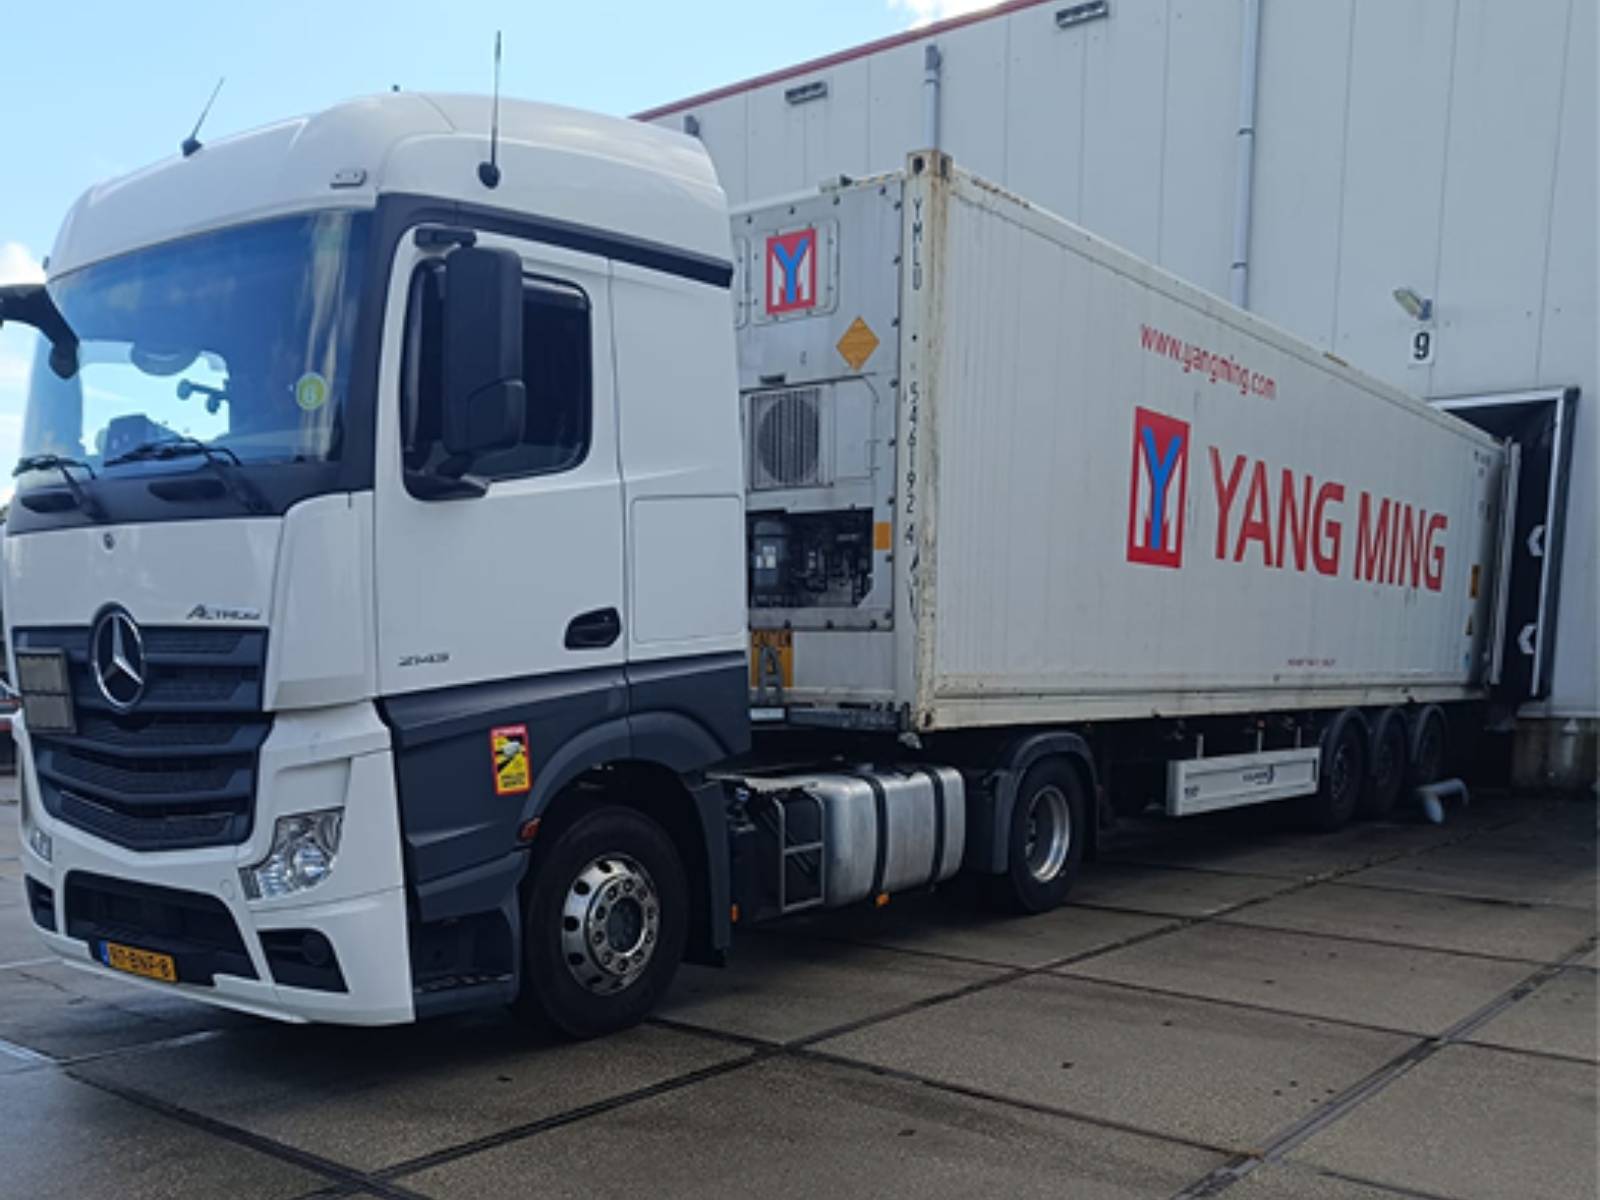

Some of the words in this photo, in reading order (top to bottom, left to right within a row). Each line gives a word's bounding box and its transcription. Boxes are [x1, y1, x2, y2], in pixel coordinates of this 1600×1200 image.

[911, 198, 924, 290] YMLU
[1140, 322, 1276, 400] www.yangming.com
[1413, 331, 1430, 360] 9
[1209, 446, 1345, 577] YANG
[1354, 491, 1447, 592] MING
